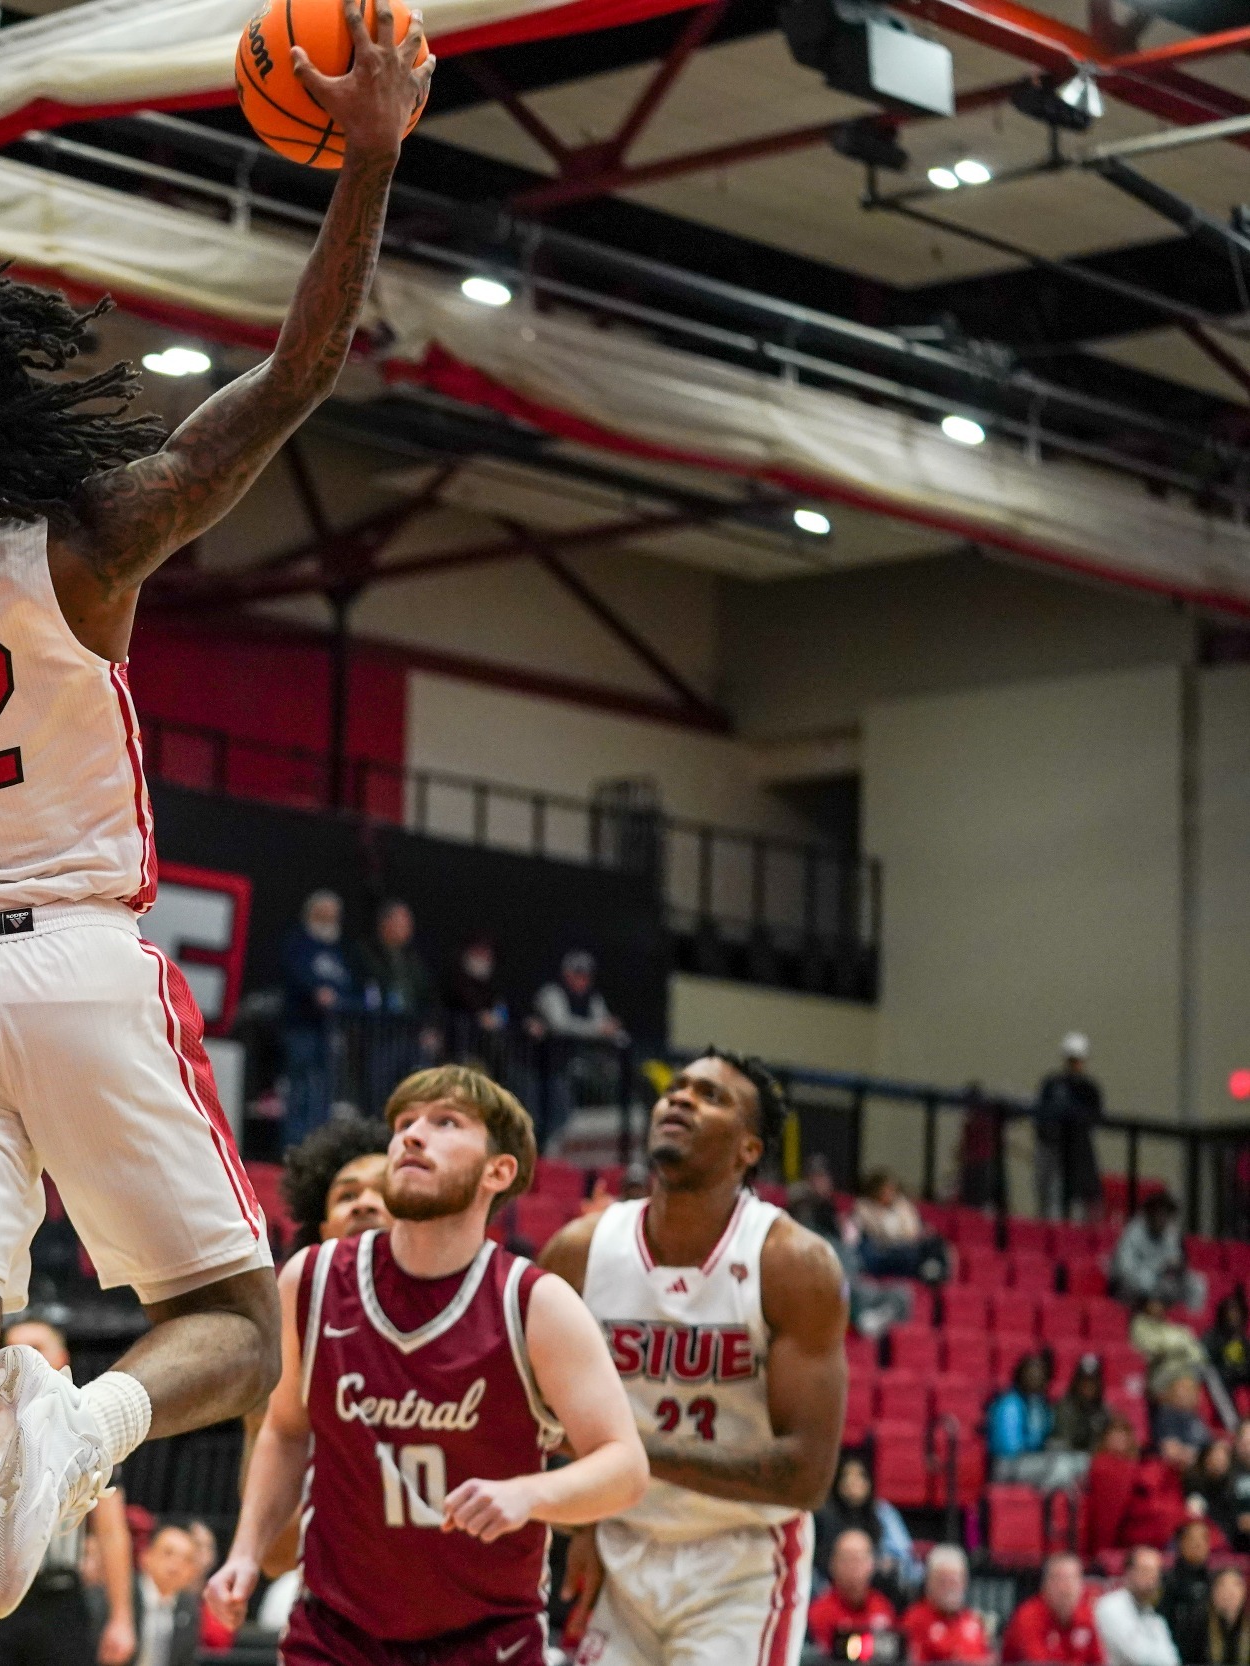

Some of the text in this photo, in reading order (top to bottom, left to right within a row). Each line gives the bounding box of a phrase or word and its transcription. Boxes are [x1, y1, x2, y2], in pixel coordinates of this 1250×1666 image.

[5, 911, 29, 919] adidas
[607, 1320, 758, 1384] SIUE
[336, 1372, 487, 1432] Central
[375, 1441, 448, 1528] 10
